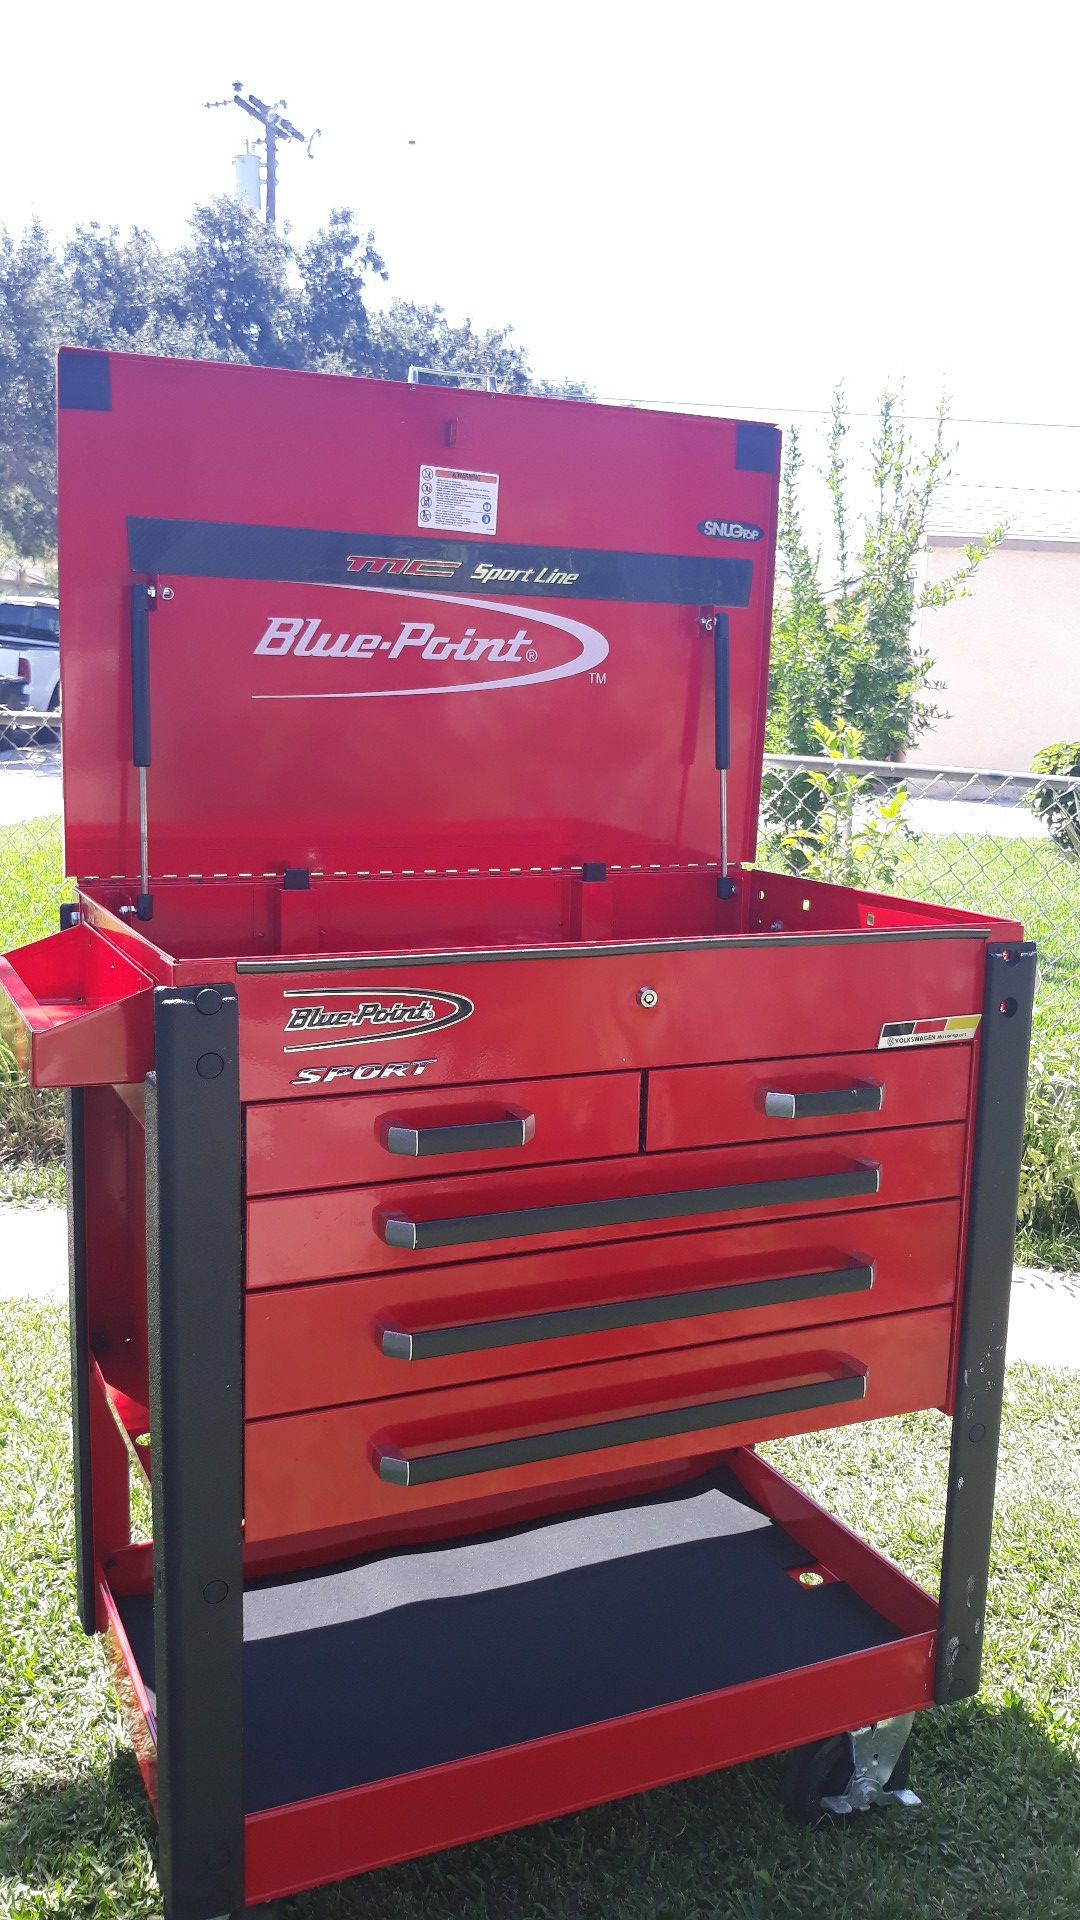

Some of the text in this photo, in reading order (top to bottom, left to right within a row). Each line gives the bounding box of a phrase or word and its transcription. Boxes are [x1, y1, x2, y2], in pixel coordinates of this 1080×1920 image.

[470, 564, 535, 583] Sport
[534, 568, 580, 585] Line
[588, 672, 607, 685] TM
[895, 1035, 936, 1044] VOLKSWAGEN
[290, 1057, 438, 1085] SPORT
